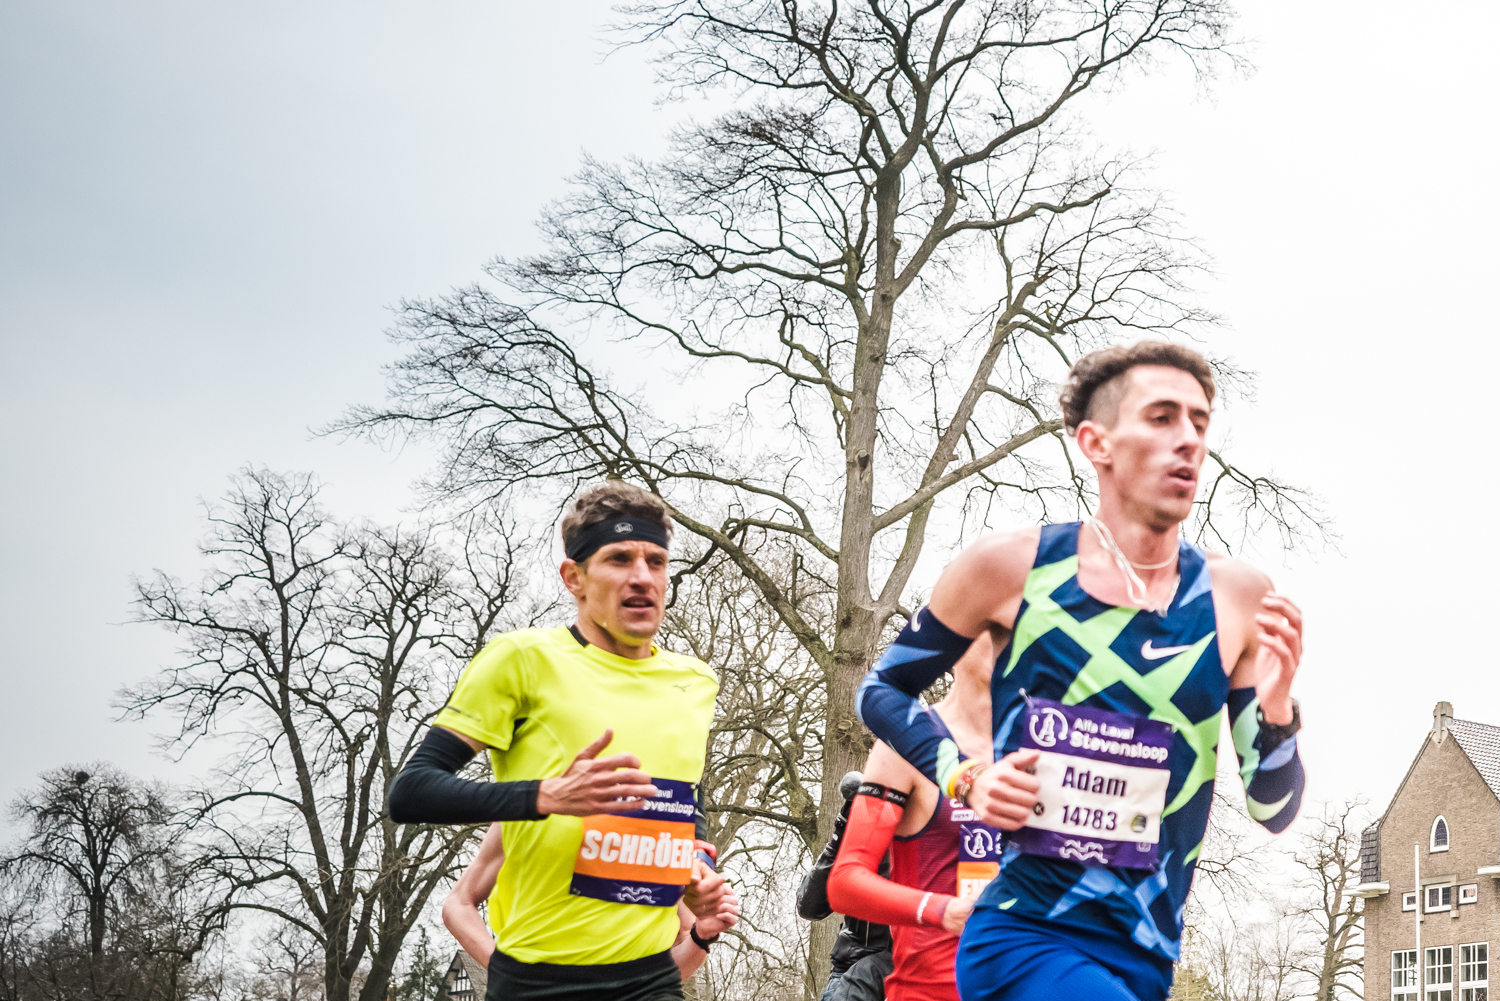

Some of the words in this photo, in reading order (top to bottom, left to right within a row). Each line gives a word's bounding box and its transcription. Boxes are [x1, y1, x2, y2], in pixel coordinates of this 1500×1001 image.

[1073, 718, 1098, 734] Alfa
[1100, 722, 1135, 740] Laval
[1069, 731, 1169, 764] Stevensloop
[656, 789, 673, 798] aval
[1062, 766, 1128, 797] Adam
[626, 796, 695, 817] evensloop
[1062, 804, 1117, 831] 14783
[581, 830, 694, 868] SCHRÖER
